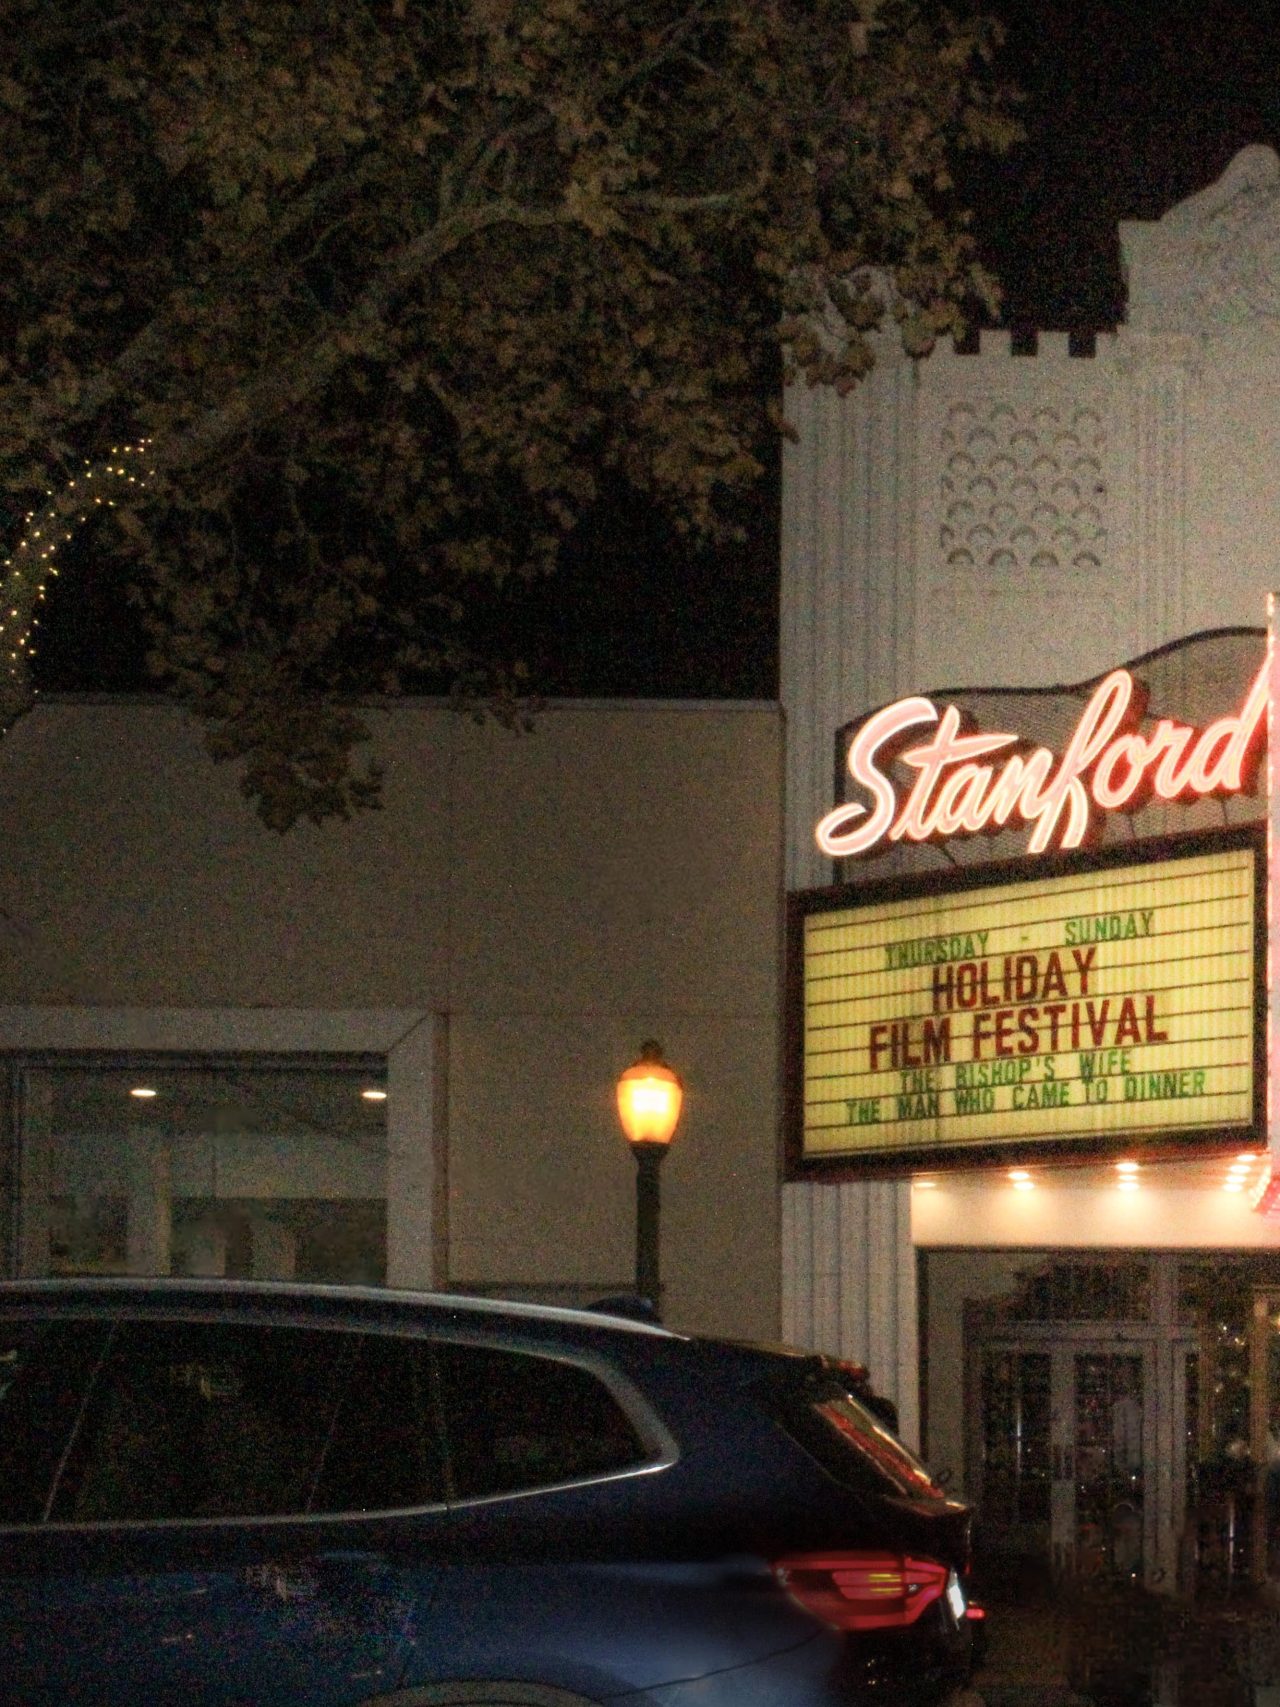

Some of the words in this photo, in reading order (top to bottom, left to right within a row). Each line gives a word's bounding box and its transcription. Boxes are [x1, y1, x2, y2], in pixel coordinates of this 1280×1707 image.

[816, 645, 1273, 856] Stanford
[884, 931, 990, 971] THURSDAY
[1064, 911, 1155, 946] SUNDAY
[931, 947, 1097, 1013] HOLIDAY
[869, 1017, 951, 1071] FILM
[972, 995, 1170, 1060] FESTIVAL
[845, 1099, 881, 1126] THE
[898, 1093, 940, 1119] MAN
[954, 1086, 995, 1116] WHO
[1012, 1081, 1071, 1110] CAME
[1082, 1078, 1109, 1104] TO
[1123, 1070, 1206, 1101] DINNER
[901, 1069, 935, 1094] THE
[954, 1055, 1056, 1089] BISHOP'S
[1079, 1049, 1132, 1084] WIFE
